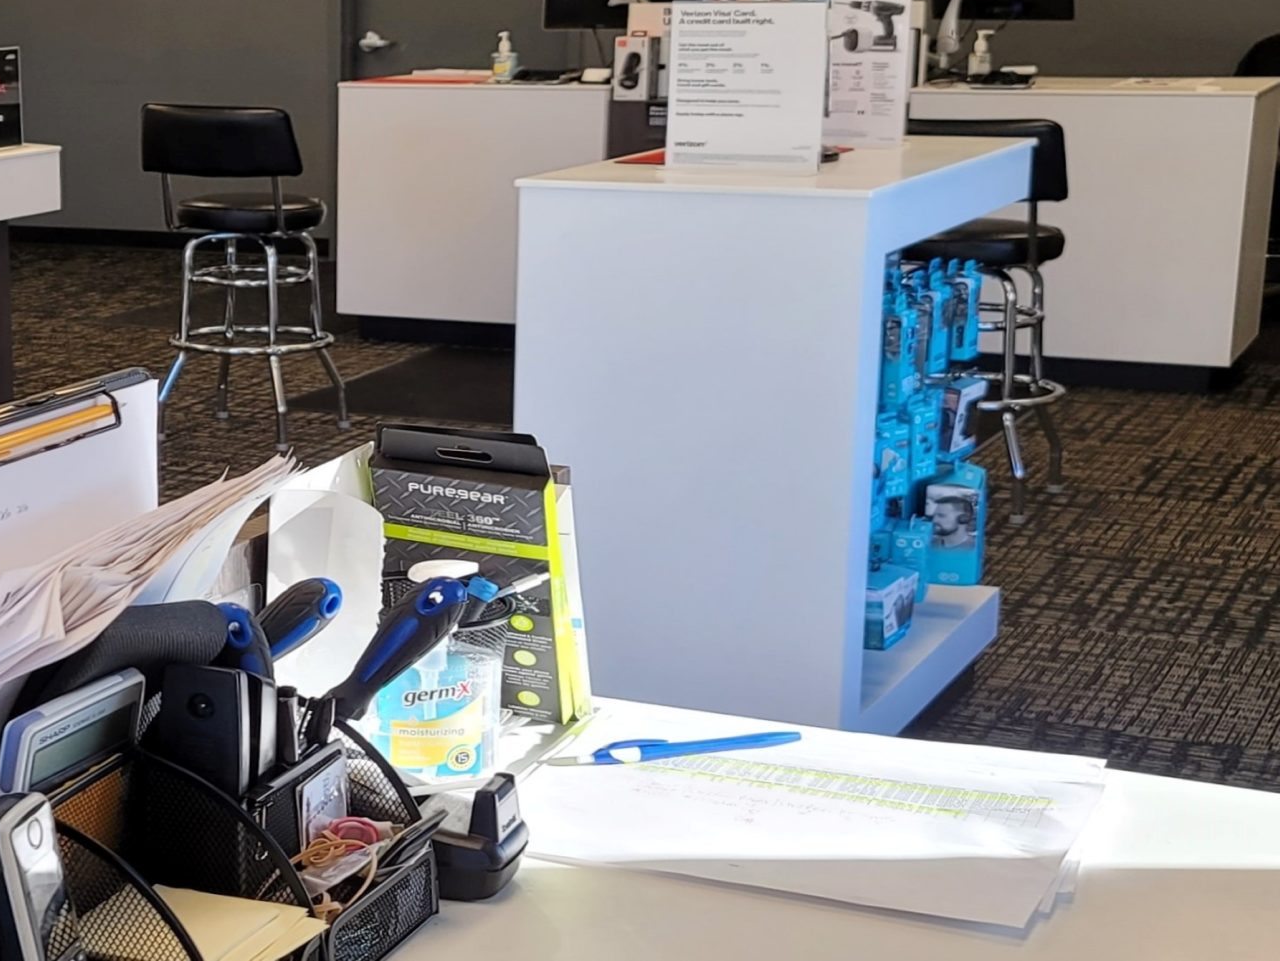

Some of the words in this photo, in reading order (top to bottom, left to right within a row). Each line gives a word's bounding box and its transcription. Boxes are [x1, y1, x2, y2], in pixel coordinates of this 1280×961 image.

[680, 9, 712, 18] Verizon
[733, 9, 757, 17] Card.
[751, 18, 775, 26] right.
[398, 727, 465, 737] moisturizing
